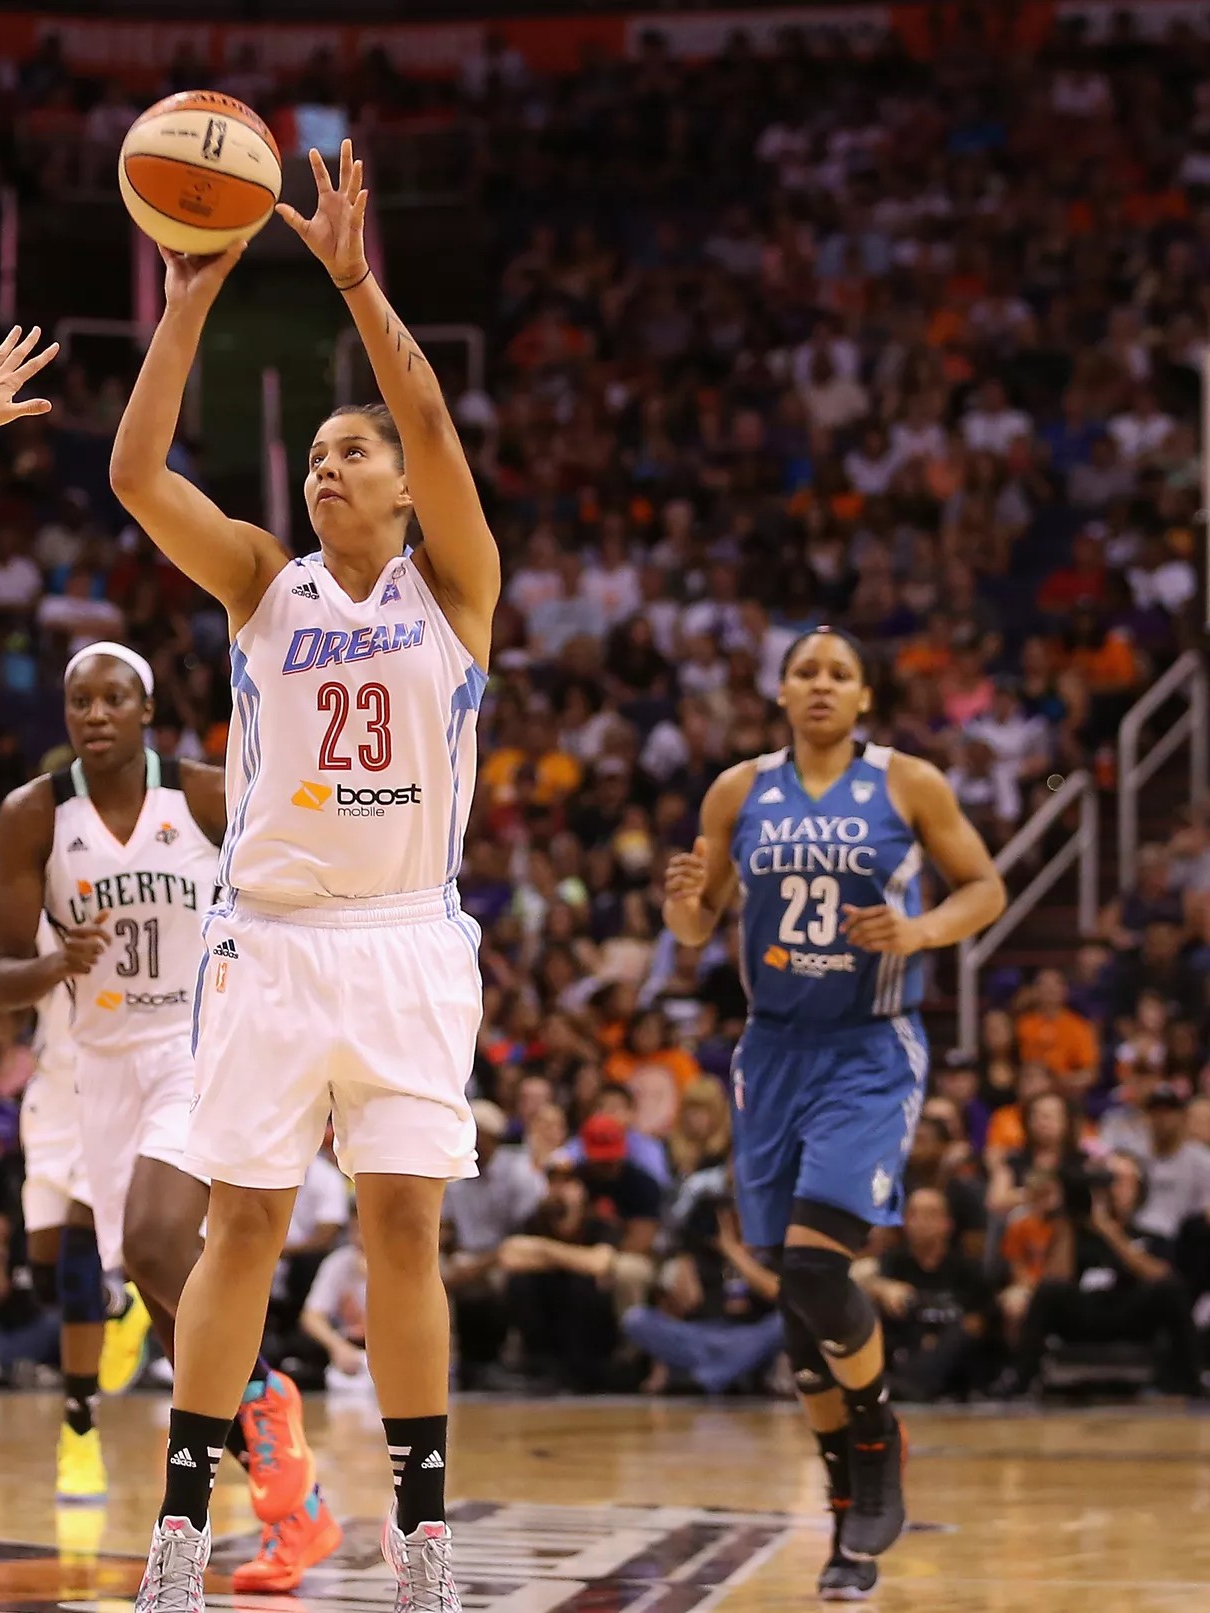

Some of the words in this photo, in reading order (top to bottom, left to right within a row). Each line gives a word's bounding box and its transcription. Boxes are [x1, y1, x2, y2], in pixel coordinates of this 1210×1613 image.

[291, 587, 320, 600] adidas
[282, 620, 425, 676] DREAM
[317, 681, 392, 772] 23
[336, 783, 422, 805] boost
[337, 806, 385, 817] mobile
[759, 816, 869, 844] MAYO
[750, 844, 878, 876] CLINIC
[778, 874, 840, 947] 23
[115, 917, 160, 978] 31
[213, 948, 239, 959] adidas
[126, 989, 188, 1006] boost
[170, 1456, 197, 1469] adidas
